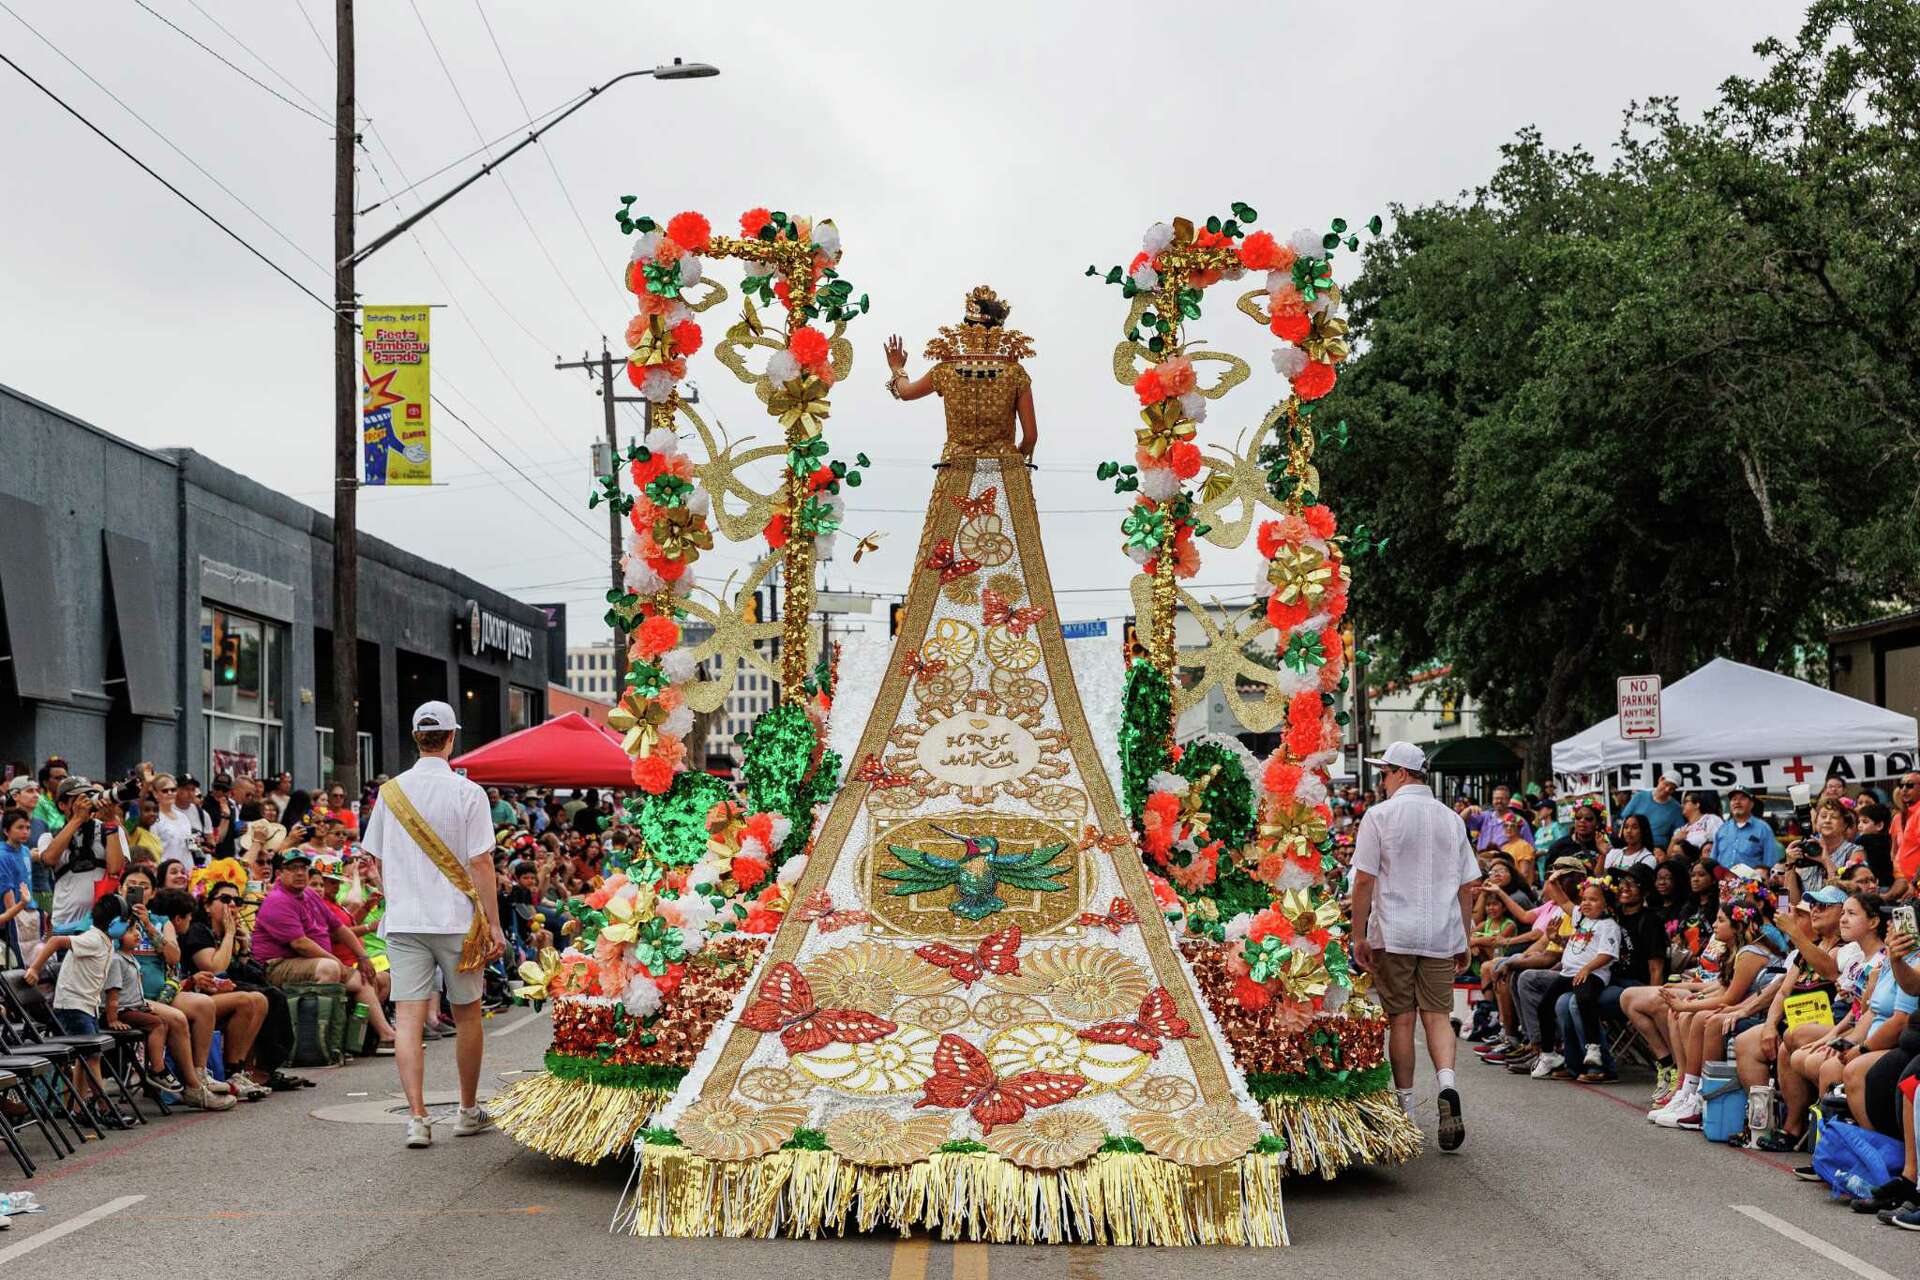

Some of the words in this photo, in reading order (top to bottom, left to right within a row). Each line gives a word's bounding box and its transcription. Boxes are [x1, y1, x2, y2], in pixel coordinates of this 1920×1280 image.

[400, 313, 416, 321] April
[376, 329, 417, 339] Fiesta
[365, 340, 427, 351] Flambeau
[373, 351, 420, 362] Parade
[1630, 680, 1648, 692] NO
[1621, 694, 1658, 707] PARKING
[1620, 759, 1772, 787] FIRST
[1826, 752, 1912, 780] AID
